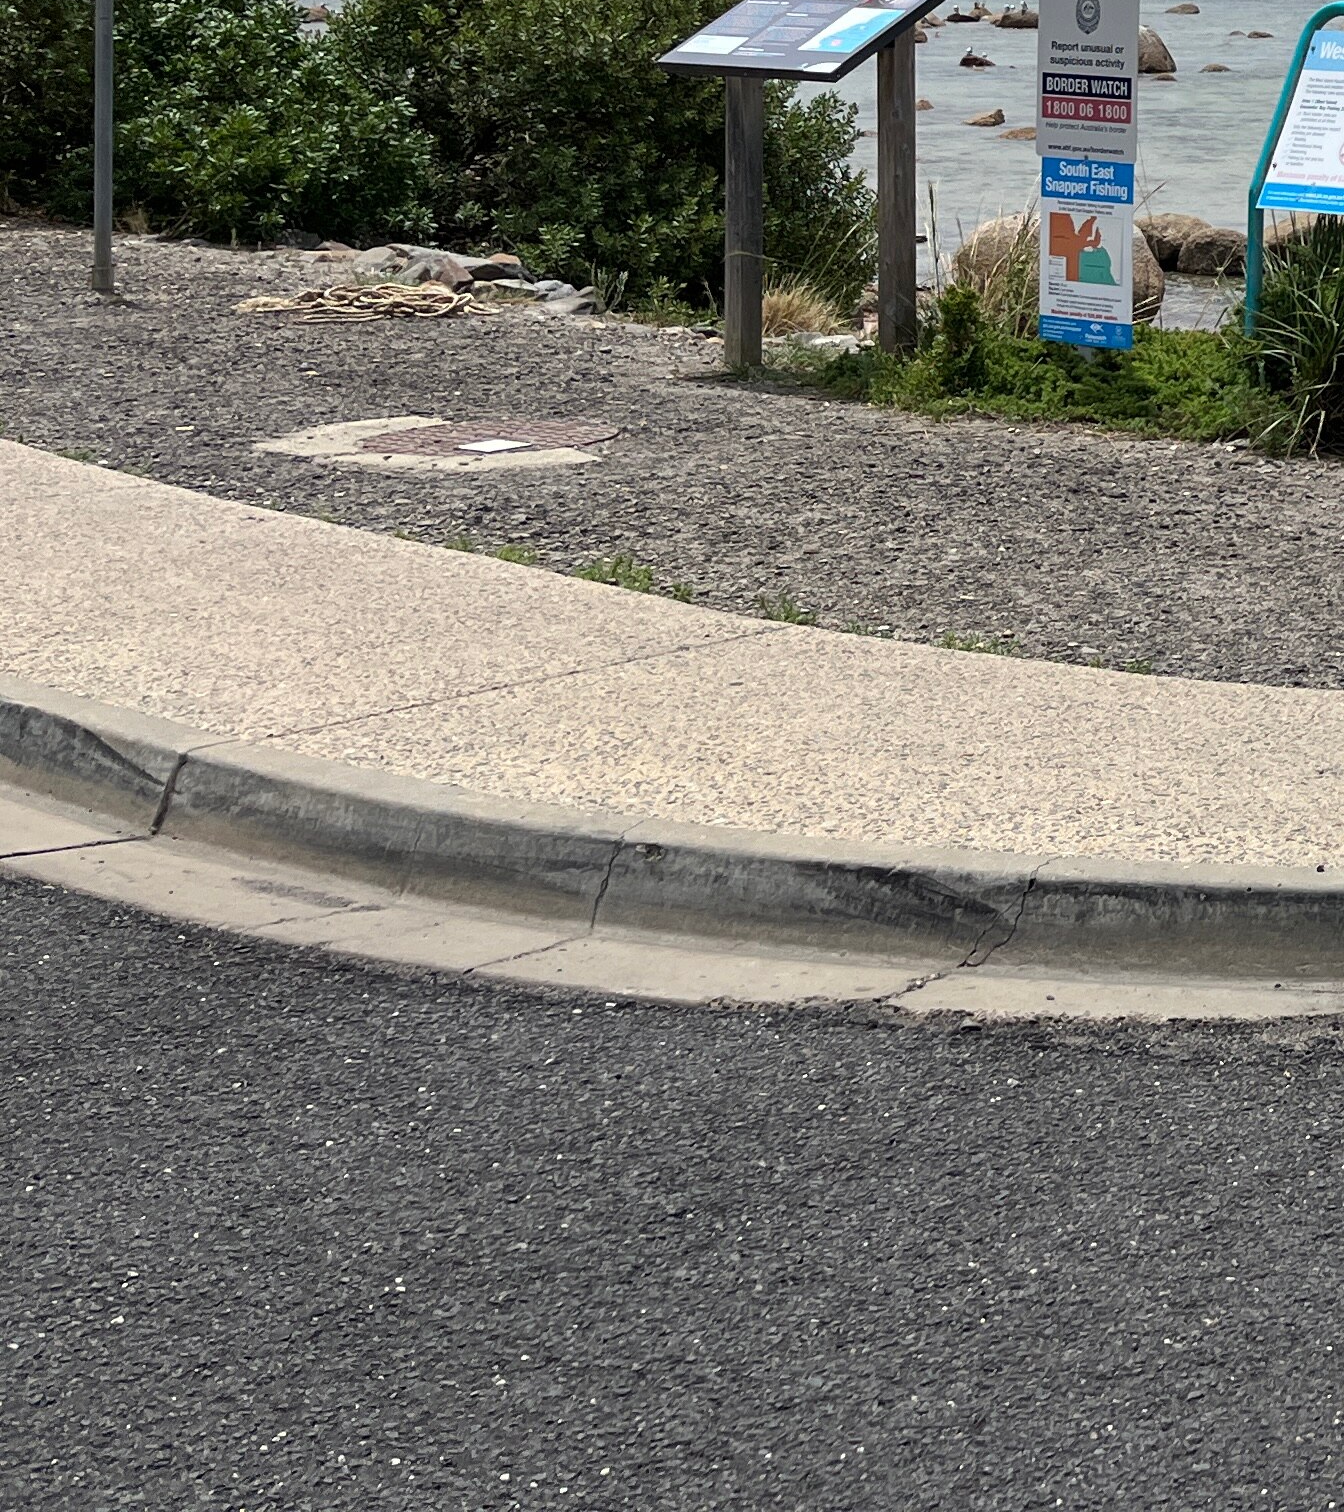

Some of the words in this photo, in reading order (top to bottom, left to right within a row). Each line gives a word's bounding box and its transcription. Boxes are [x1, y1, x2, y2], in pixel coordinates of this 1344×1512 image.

[1051, 41, 1078, 52] Report
[1081, 44, 1113, 53] unusual
[1050, 57, 1093, 66] suspicious
[1095, 59, 1125, 70] activity
[1047, 77, 1088, 93] BORDER
[1091, 80, 1127, 96] WATCH
[1047, 101, 1074, 115] 1800
[1080, 103, 1093, 117] 06
[1099, 104, 1127, 119] 1800
[1059, 161, 1089, 177] South
[1092, 164, 1114, 179] East
[1046, 177, 1088, 196] Snapper
[1090, 181, 1127, 200] Fishing
